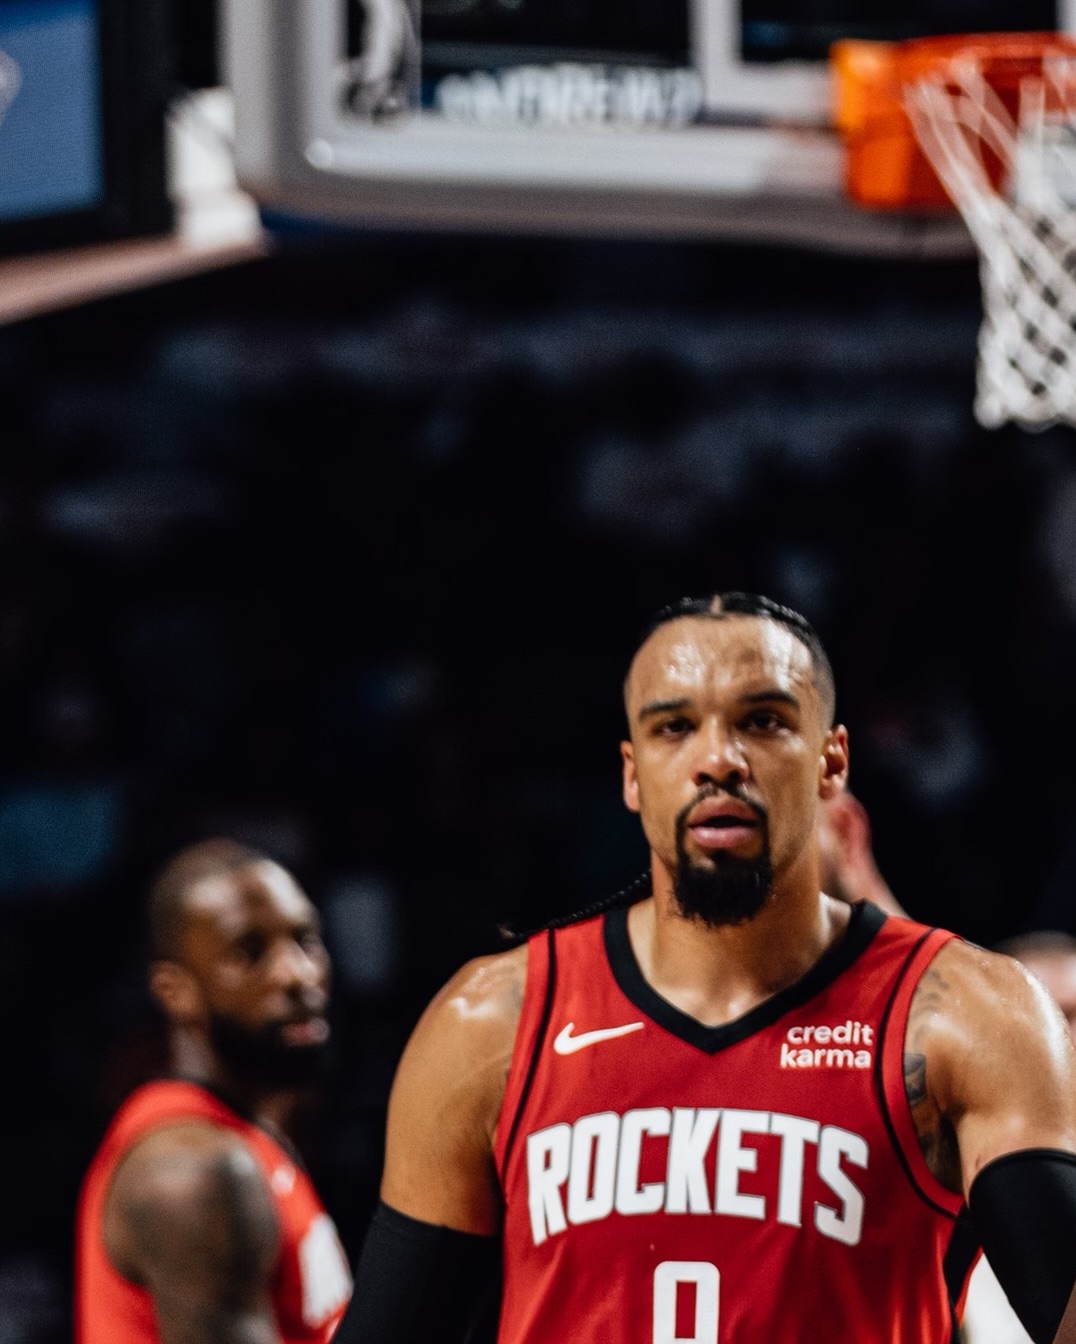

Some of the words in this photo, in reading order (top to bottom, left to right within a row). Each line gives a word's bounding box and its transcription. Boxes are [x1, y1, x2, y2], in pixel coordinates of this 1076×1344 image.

[787, 1020, 873, 1046] credit
[780, 1043, 871, 1068] karma
[527, 1108, 867, 1244] ROCKETS
